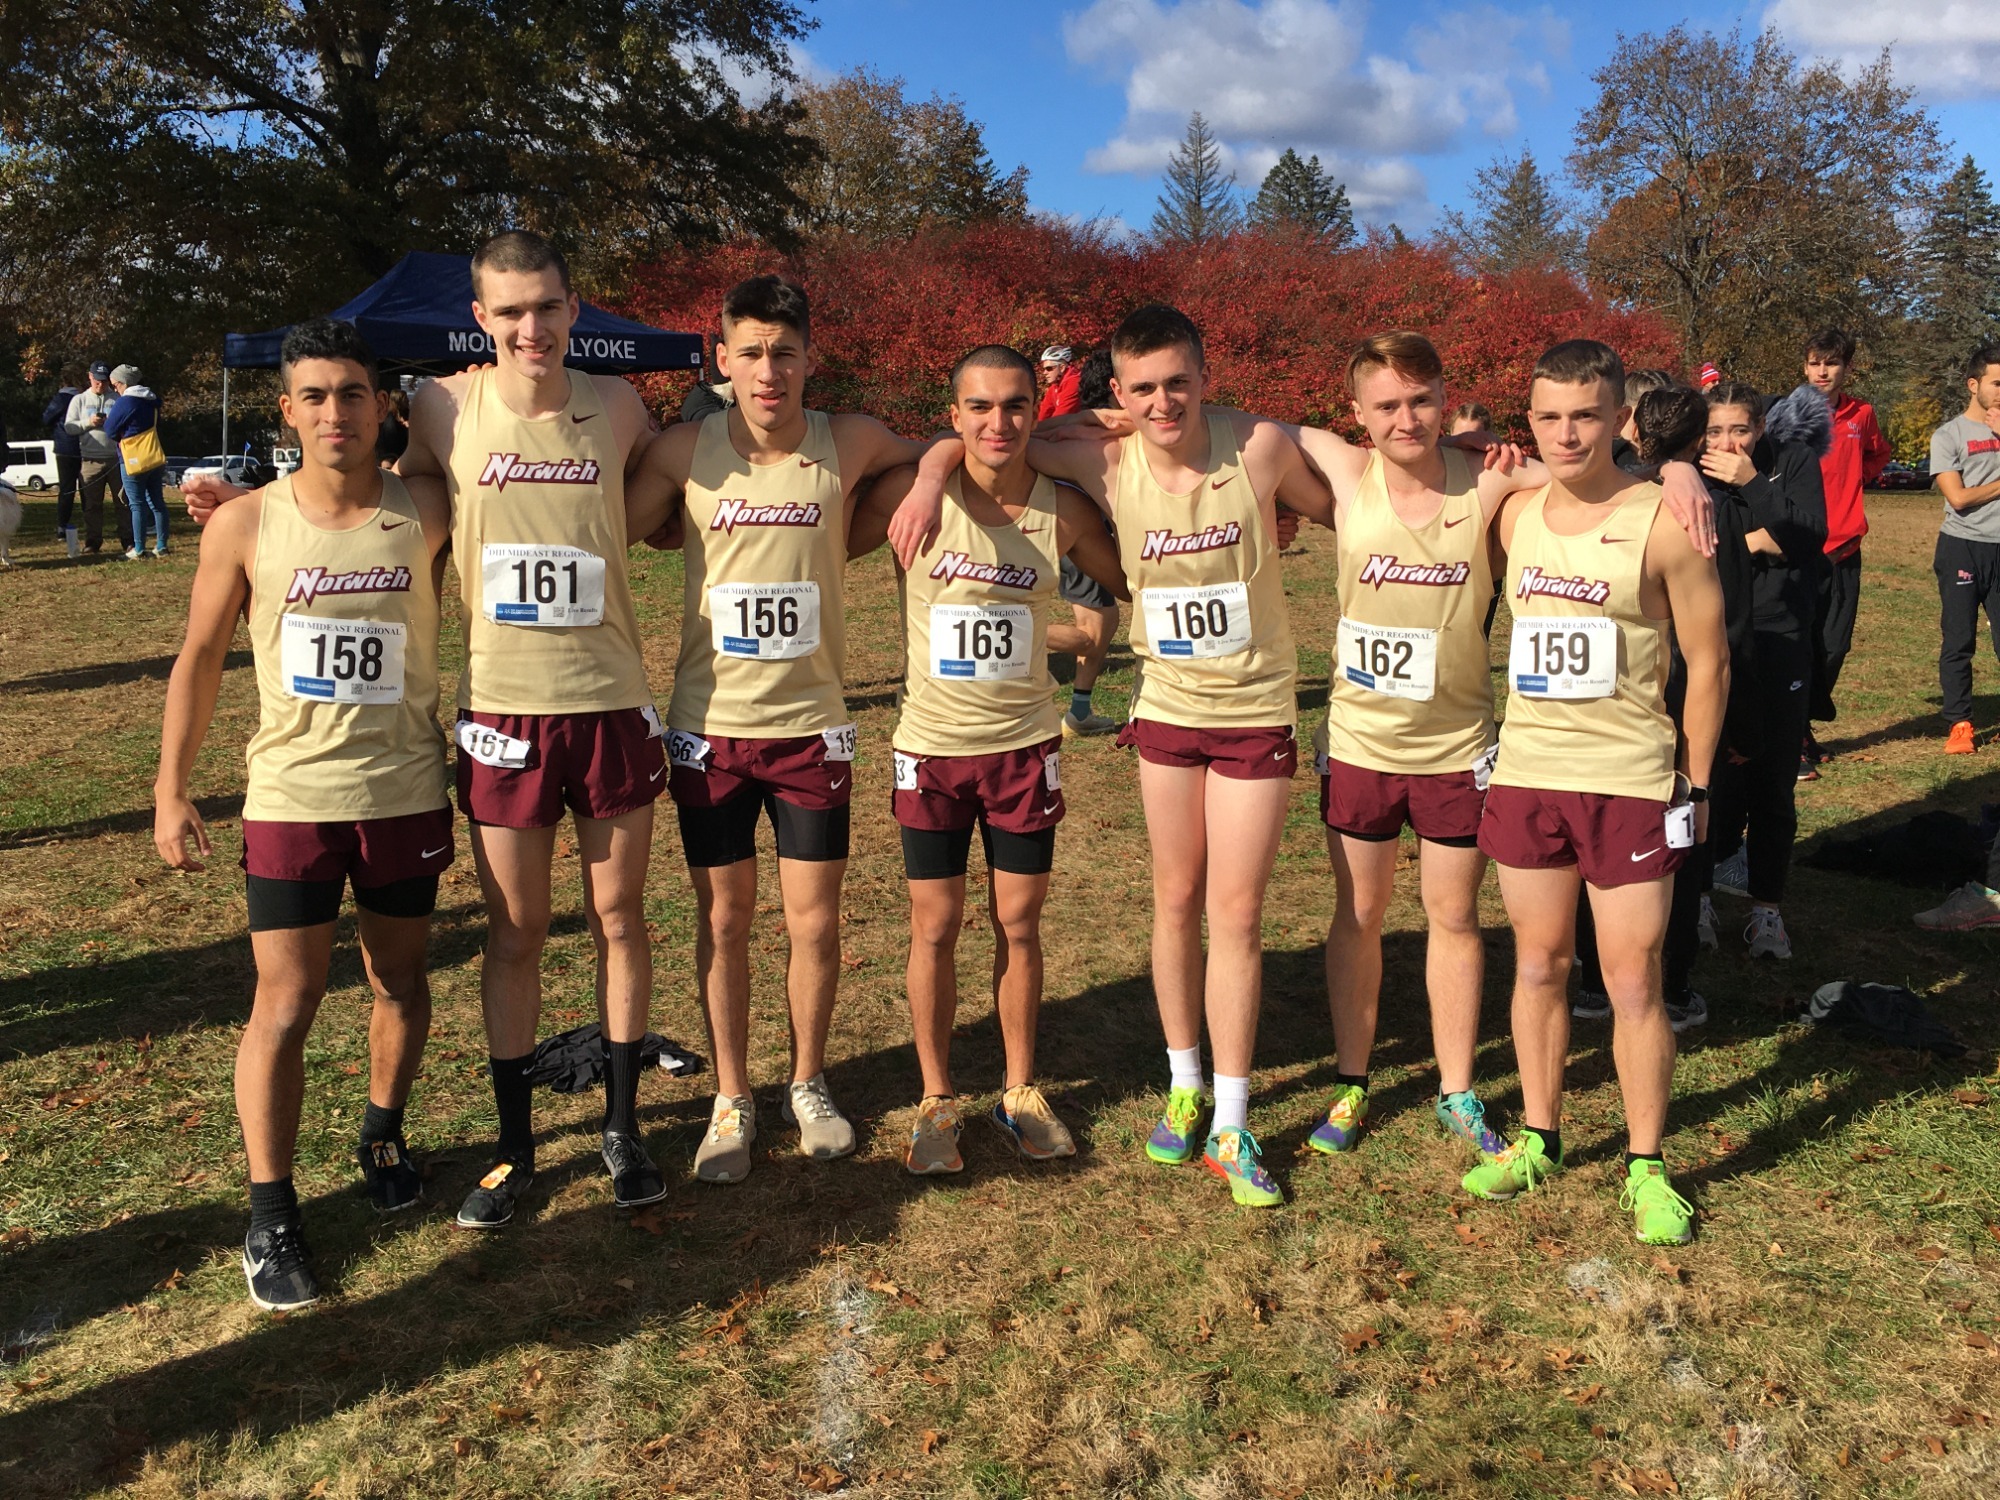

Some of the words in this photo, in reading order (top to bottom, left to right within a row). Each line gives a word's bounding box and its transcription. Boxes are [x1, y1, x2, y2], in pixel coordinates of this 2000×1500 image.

[448, 331, 498, 353] MOU
[566, 338, 637, 359] LYOKE
[478, 452, 600, 493] Norwich
[710, 499, 821, 536] Norwich
[507, 549, 549, 558] MIDEAST
[551, 550, 599, 559] REGIONA
[1140, 521, 1242, 565] Norwich
[285, 566, 412, 608] Norwich
[511, 559, 578, 604] 161
[930, 550, 1038, 589] Norwich
[1359, 554, 1470, 592] Norwich
[1517, 566, 1610, 606] Norwich
[730, 588, 769, 596] MIDEAST
[771, 586, 815, 595] REGIONAL
[288, 620, 305, 629] DIII
[307, 622, 352, 633] MIDEAST
[354, 626, 402, 636] REGIONAL
[734, 596, 799, 639] 156
[988, 609, 1028, 617] REGIONAL
[1166, 598, 1228, 640] 160
[1351, 624, 1385, 638] MIDEAST
[1386, 631, 1432, 640] REGIONAL
[1561, 622, 1611, 630] REGIONAL
[310, 634, 384, 682] 158
[952, 619, 1013, 660] 163
[1354, 636, 1413, 680] 162
[1529, 631, 1590, 676] 159
[468, 729, 511, 761] 161
